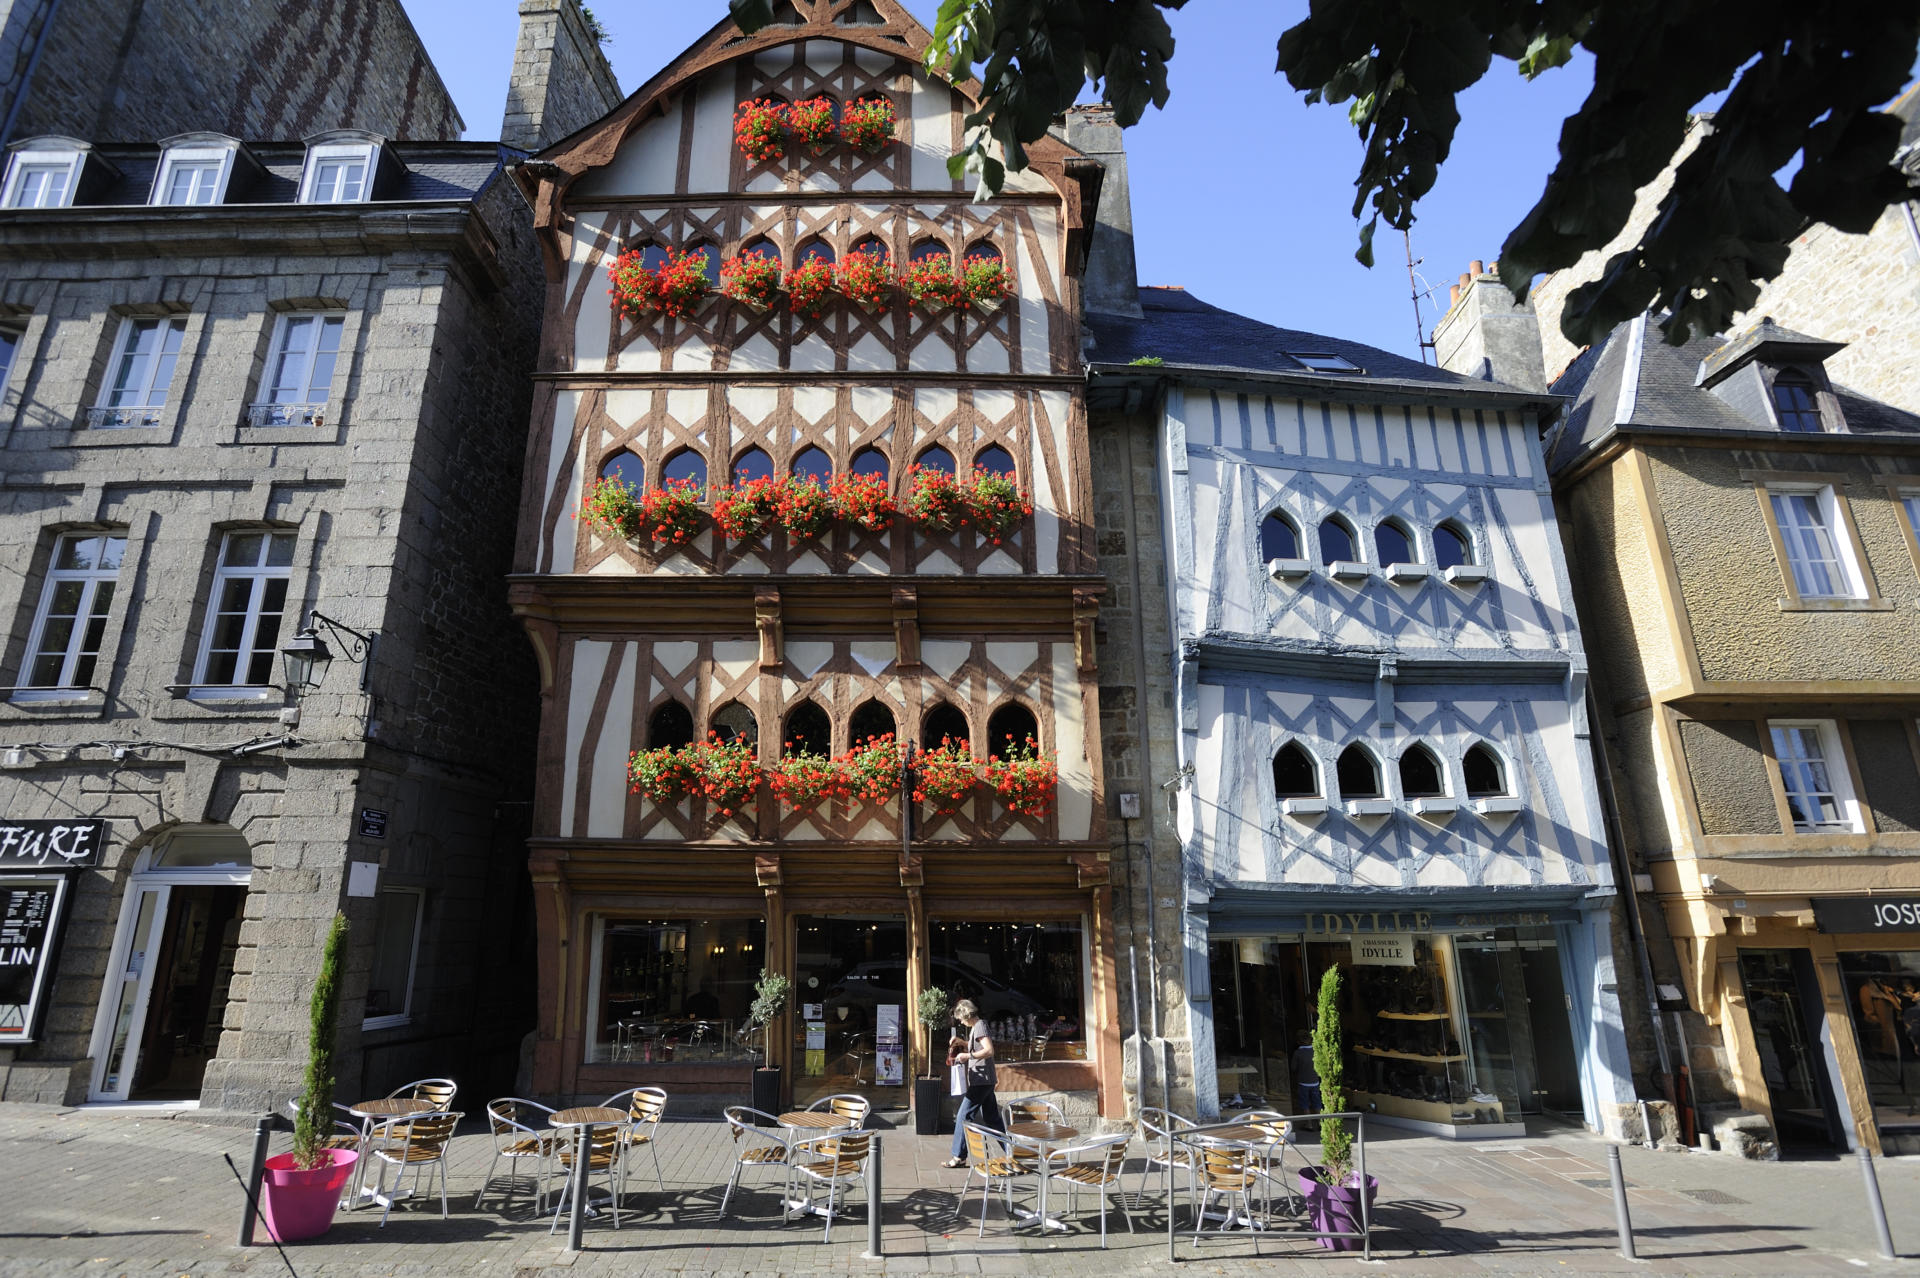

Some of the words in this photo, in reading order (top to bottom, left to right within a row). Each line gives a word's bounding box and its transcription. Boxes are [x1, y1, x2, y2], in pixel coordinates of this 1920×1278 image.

[0, 825, 95, 865] FURE
[1304, 911, 1433, 935] IDYLLE
[1361, 948, 1404, 958] IDYLLE
